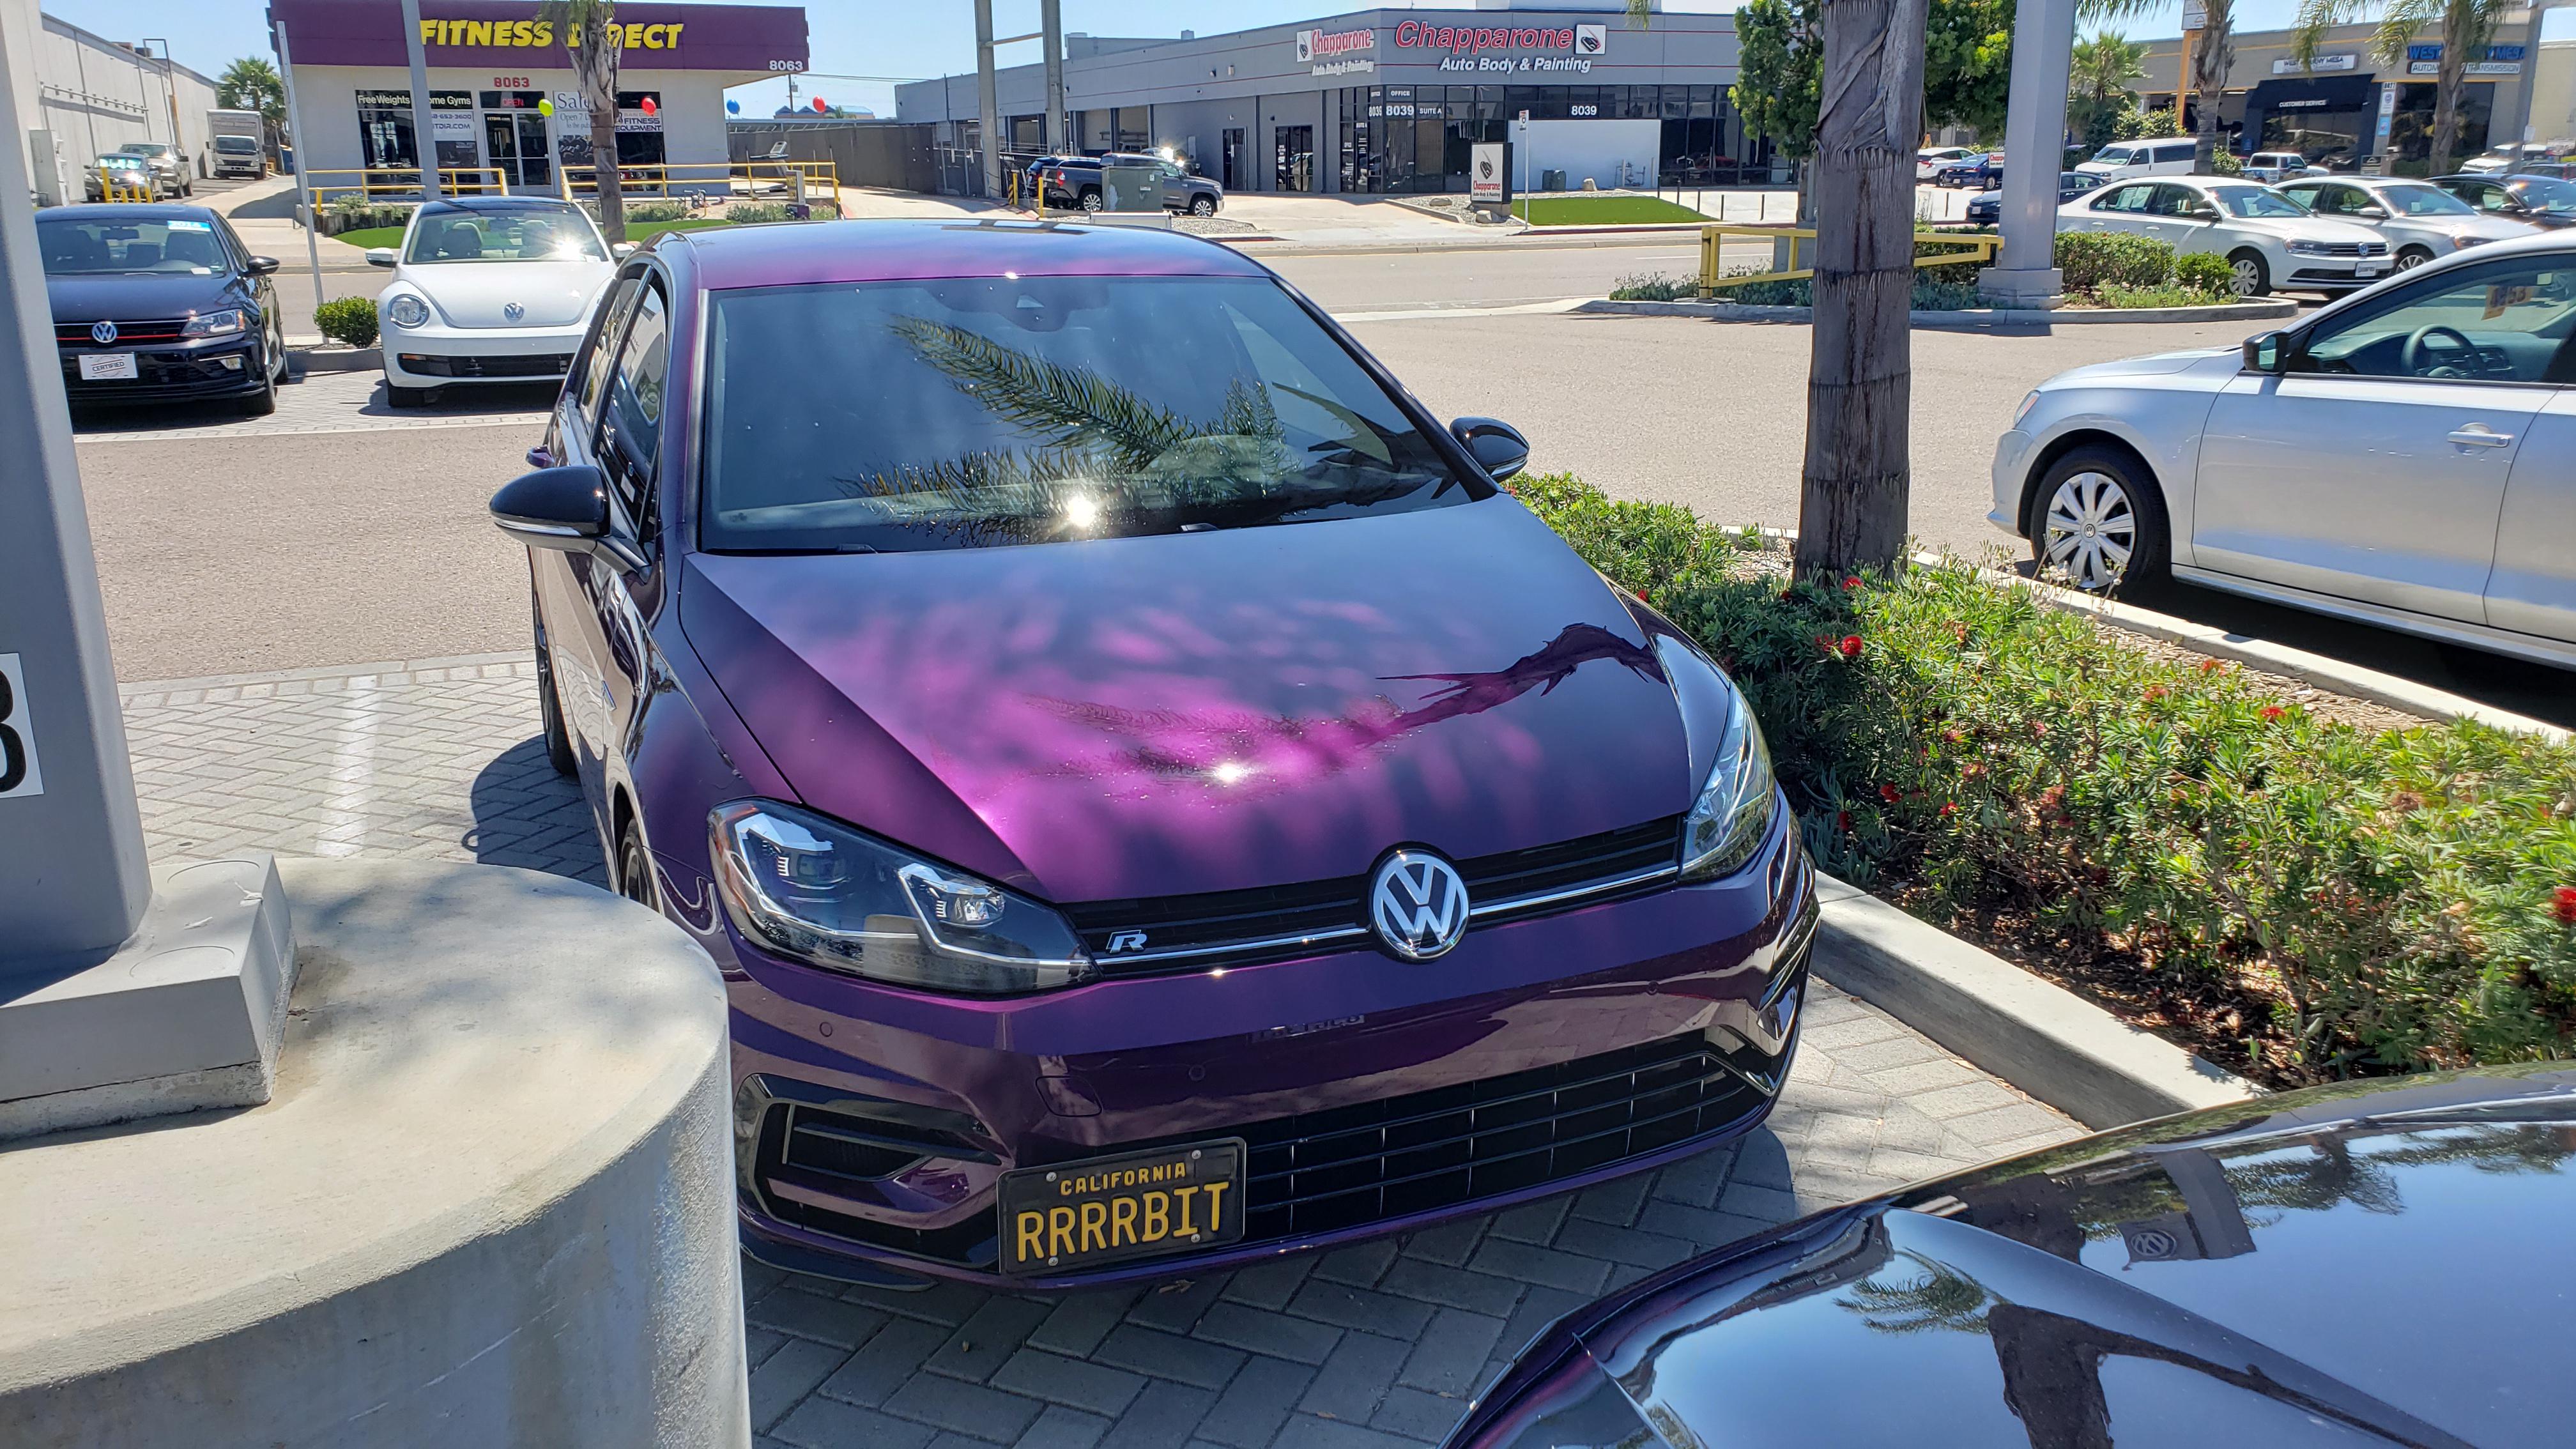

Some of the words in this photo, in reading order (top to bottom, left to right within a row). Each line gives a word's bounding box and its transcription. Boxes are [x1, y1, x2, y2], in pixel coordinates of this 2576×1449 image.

[419, 20, 553, 47] FITNESS
[1312, 29, 1374, 56] Chapparone
[1395, 20, 1573, 55] Chapparone
[769, 60, 803, 71] 8063
[1312, 65, 1326, 76] Auto
[1347, 59, 1374, 72] Painting
[1439, 57, 1476, 72] Auto
[1478, 57, 1516, 74] Body
[1519, 57, 1531, 72] &
[1534, 56, 1591, 73] Painting
[493, 77, 530, 88] 8063
[447, 96, 471, 107] Gyms
[1386, 105, 1414, 116] 8039
[1572, 105, 1597, 115] 8039
[1368, 105, 1382, 117] 8039
[92, 321, 117, 343] VW
[92, 362, 125, 372] CERTIFIED
[1374, 852, 1469, 956] VW
[1107, 930, 1147, 953] R
[1060, 1162, 1186, 1196] CALIFORNIA
[1017, 1181, 1229, 1262] RRRRBIT
